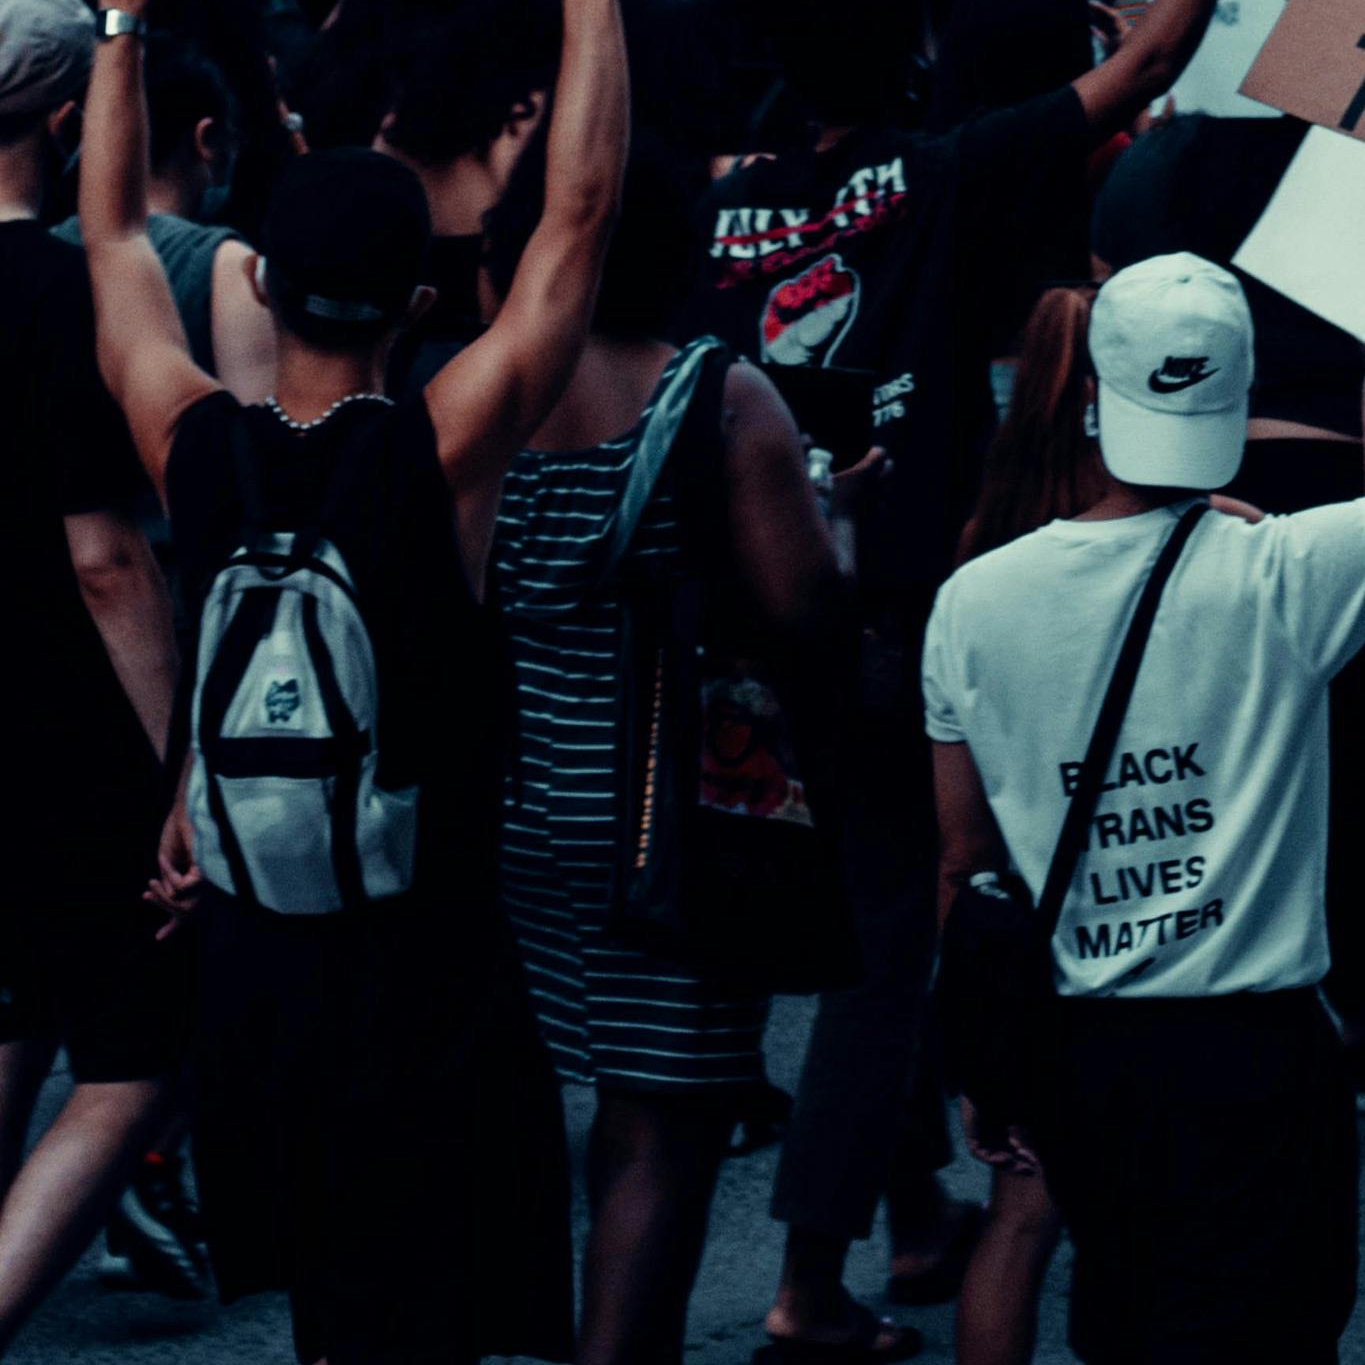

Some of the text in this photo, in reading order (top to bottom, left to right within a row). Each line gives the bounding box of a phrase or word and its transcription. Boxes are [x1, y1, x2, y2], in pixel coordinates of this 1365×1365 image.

[1082, 798, 1215, 853] RANS
[1090, 856, 1207, 906] LIVES
[1075, 898, 1224, 960] MATTER
